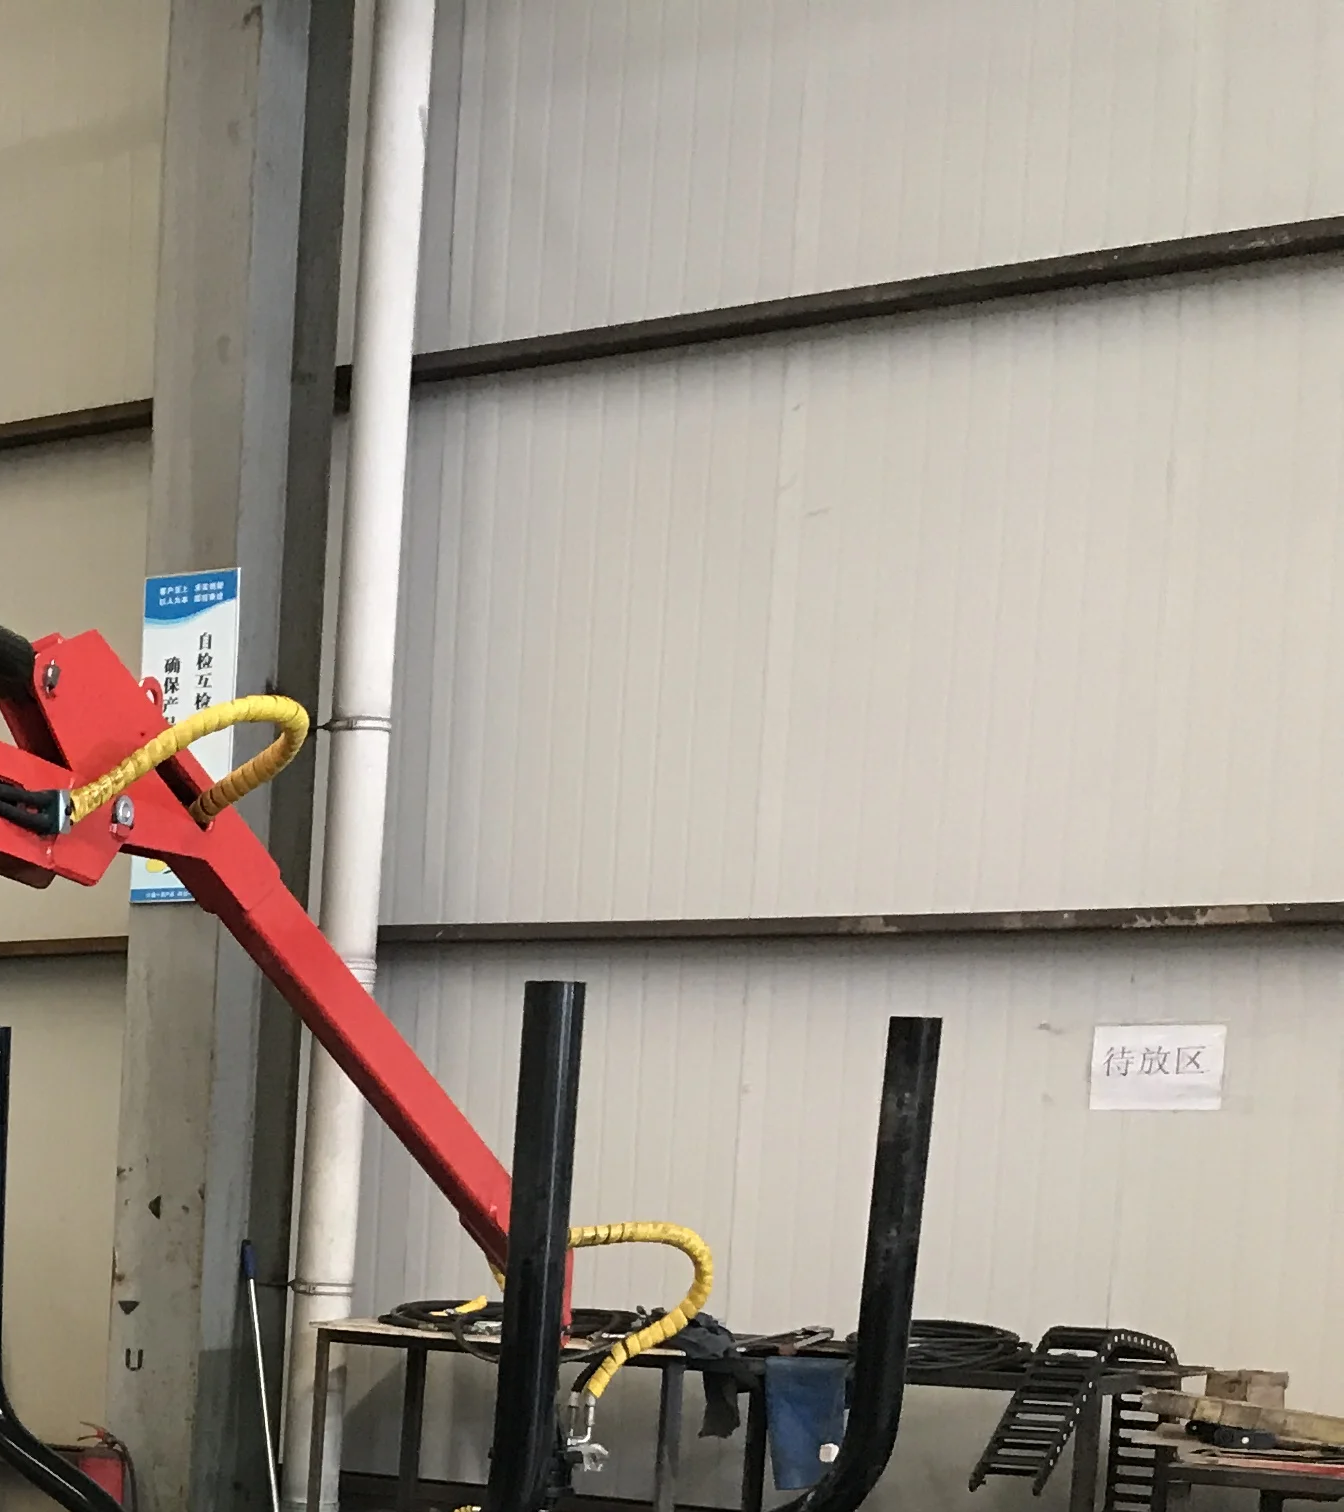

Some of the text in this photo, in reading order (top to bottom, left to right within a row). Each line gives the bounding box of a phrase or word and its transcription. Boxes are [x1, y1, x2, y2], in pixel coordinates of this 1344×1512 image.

[195, 632, 213, 711] 自检互检
[1103, 1045, 1210, 1077] 待放区
